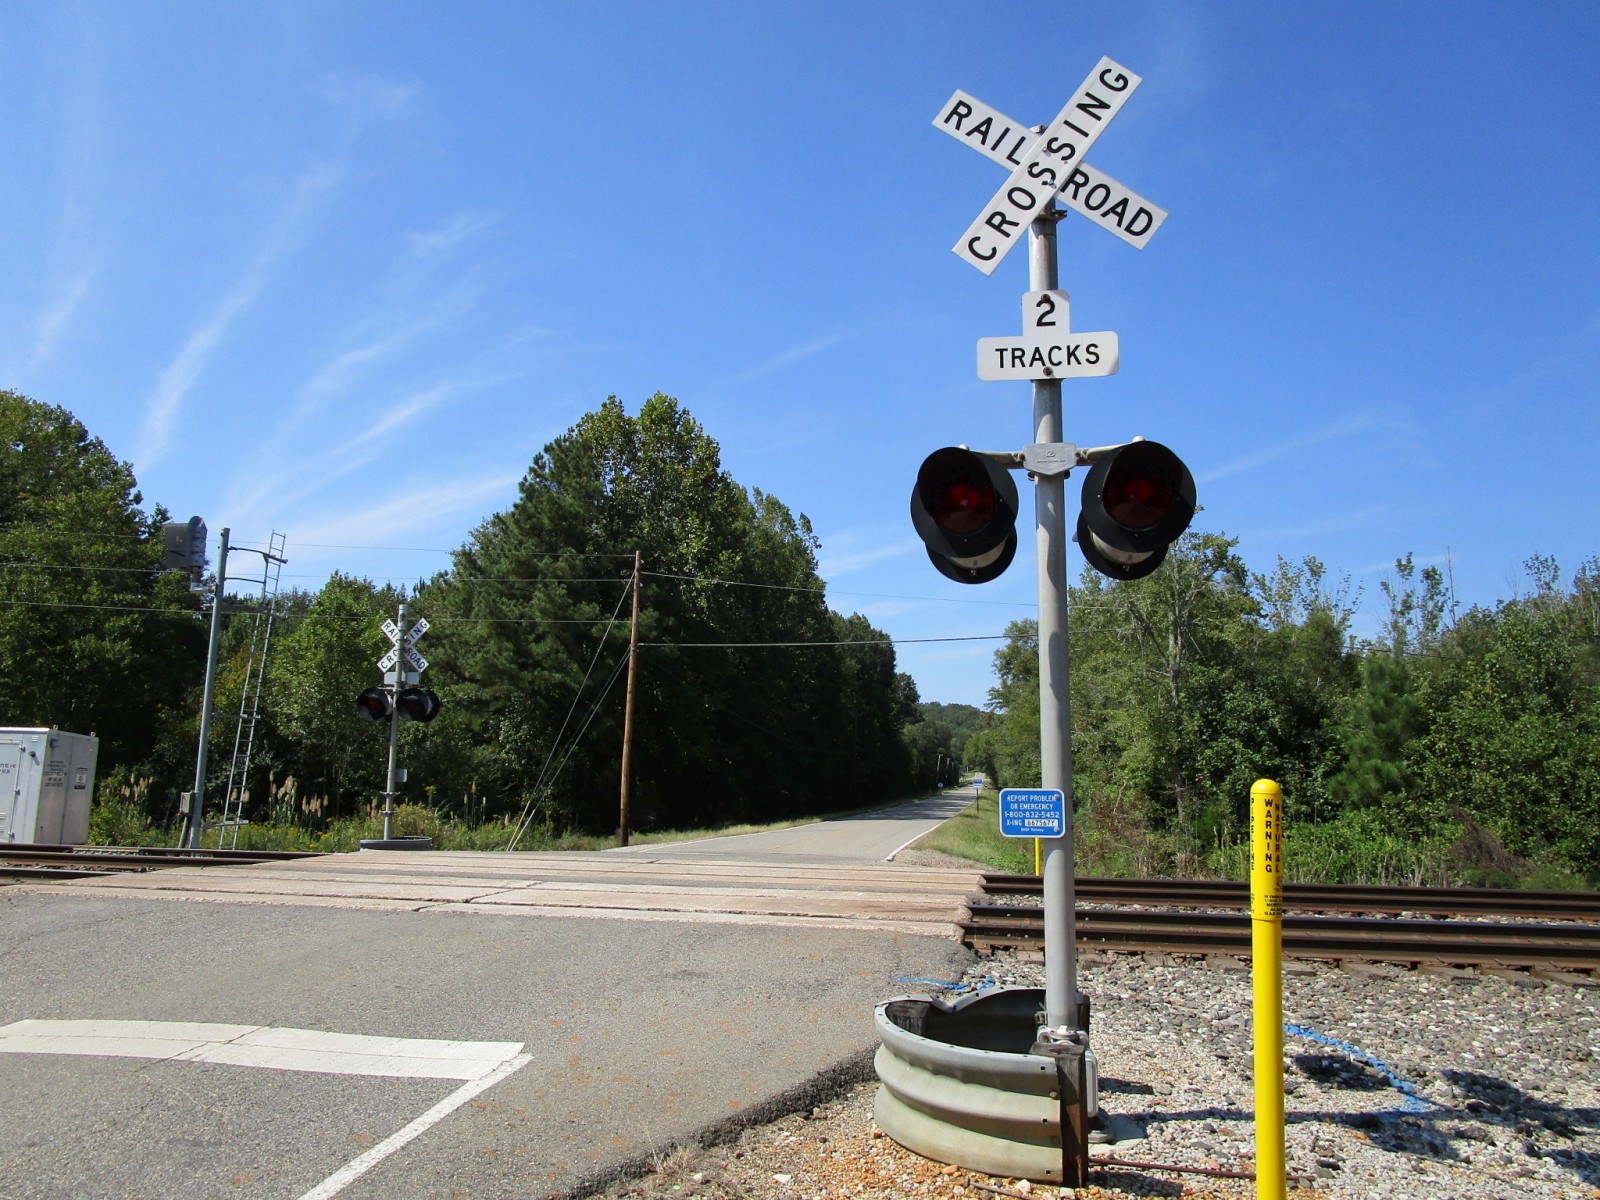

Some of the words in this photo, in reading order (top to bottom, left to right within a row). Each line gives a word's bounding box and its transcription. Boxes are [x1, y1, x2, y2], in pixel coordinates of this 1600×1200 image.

[944, 100, 1026, 165] RAIL
[1060, 168, 1153, 237] ROAD
[968, 68, 1129, 261] CROSSING
[1035, 298, 1056, 327] 2
[995, 343, 1100, 369] TRACKS
[406, 648, 426, 669] ROAD
[1264, 798, 1273, 873] WARNING
